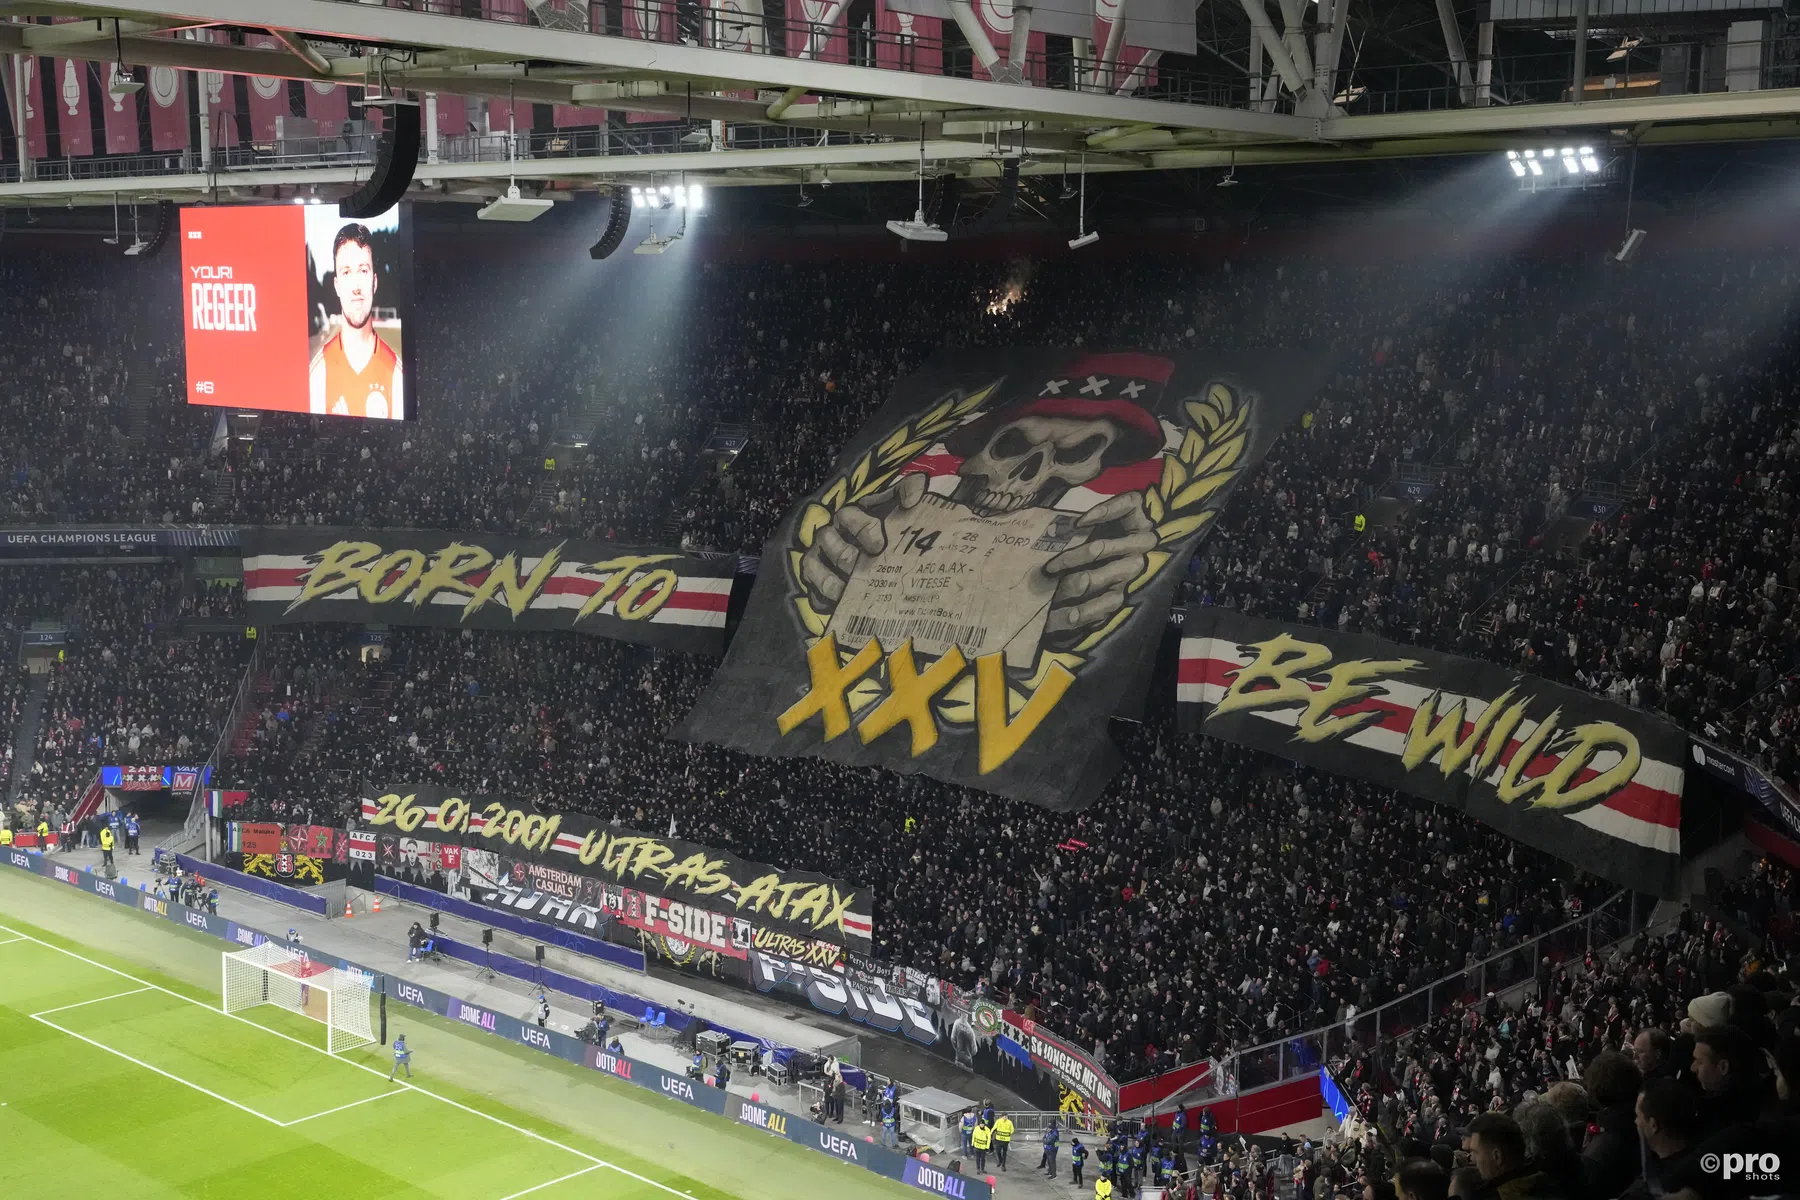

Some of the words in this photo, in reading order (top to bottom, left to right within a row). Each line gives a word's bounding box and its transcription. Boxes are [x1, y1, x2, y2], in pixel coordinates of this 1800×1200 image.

[190, 266, 233, 279] YOURI
[191, 283, 257, 331] REGEER
[195, 381, 214, 394] #6
[1407, 486, 1420, 494] 429
[1592, 505, 1606, 514] 430
[8, 535, 37, 543] UEFA
[41, 534, 110, 543] CHAMPIONS
[113, 533, 157, 543] LEAGUE
[282, 538, 568, 623] BORN
[572, 553, 686, 626] TO
[910, 576, 951, 589] VITESSE
[776, 630, 1077, 776] XXV
[1205, 632, 1430, 743] BE
[1402, 684, 1643, 811] WILD
[1706, 756, 1735, 776] mastercard
[175, 776, 193, 789] M
[10, 852, 30, 869] UEFA
[355, 850, 373, 858] 023
[444, 847, 459, 855] VAK
[68, 869, 79, 885] ALL
[369, 793, 426, 832] 26
[480, 802, 563, 853] 2001
[578, 828, 732, 895] ULTRAS
[734, 873, 856, 940] AJAX
[528, 864, 582, 888] AMSTERDAM
[95, 879, 115, 898] UEFA
[535, 878, 574, 898] CASUALS
[186, 910, 208, 929] UEFA
[644, 894, 727, 948] F-SIDE
[754, 927, 806, 956] ULTRAS
[802, 942, 840, 967] XXV
[849, 953, 865, 969] Perry
[876, 966, 892, 977] Boys
[398, 983, 424, 1005] UEFA
[459, 1004, 481, 1025] COME
[481, 1011, 496, 1031] ALL
[521, 1026, 550, 1049] UEFA
[661, 1075, 694, 1100] UEFA
[1082, 1067, 1098, 1093] MET
[1097, 1082, 1112, 1109] ONS
[739, 1102, 767, 1128] COME
[767, 1112, 787, 1135] ALL
[819, 1131, 858, 1160] UEFA
